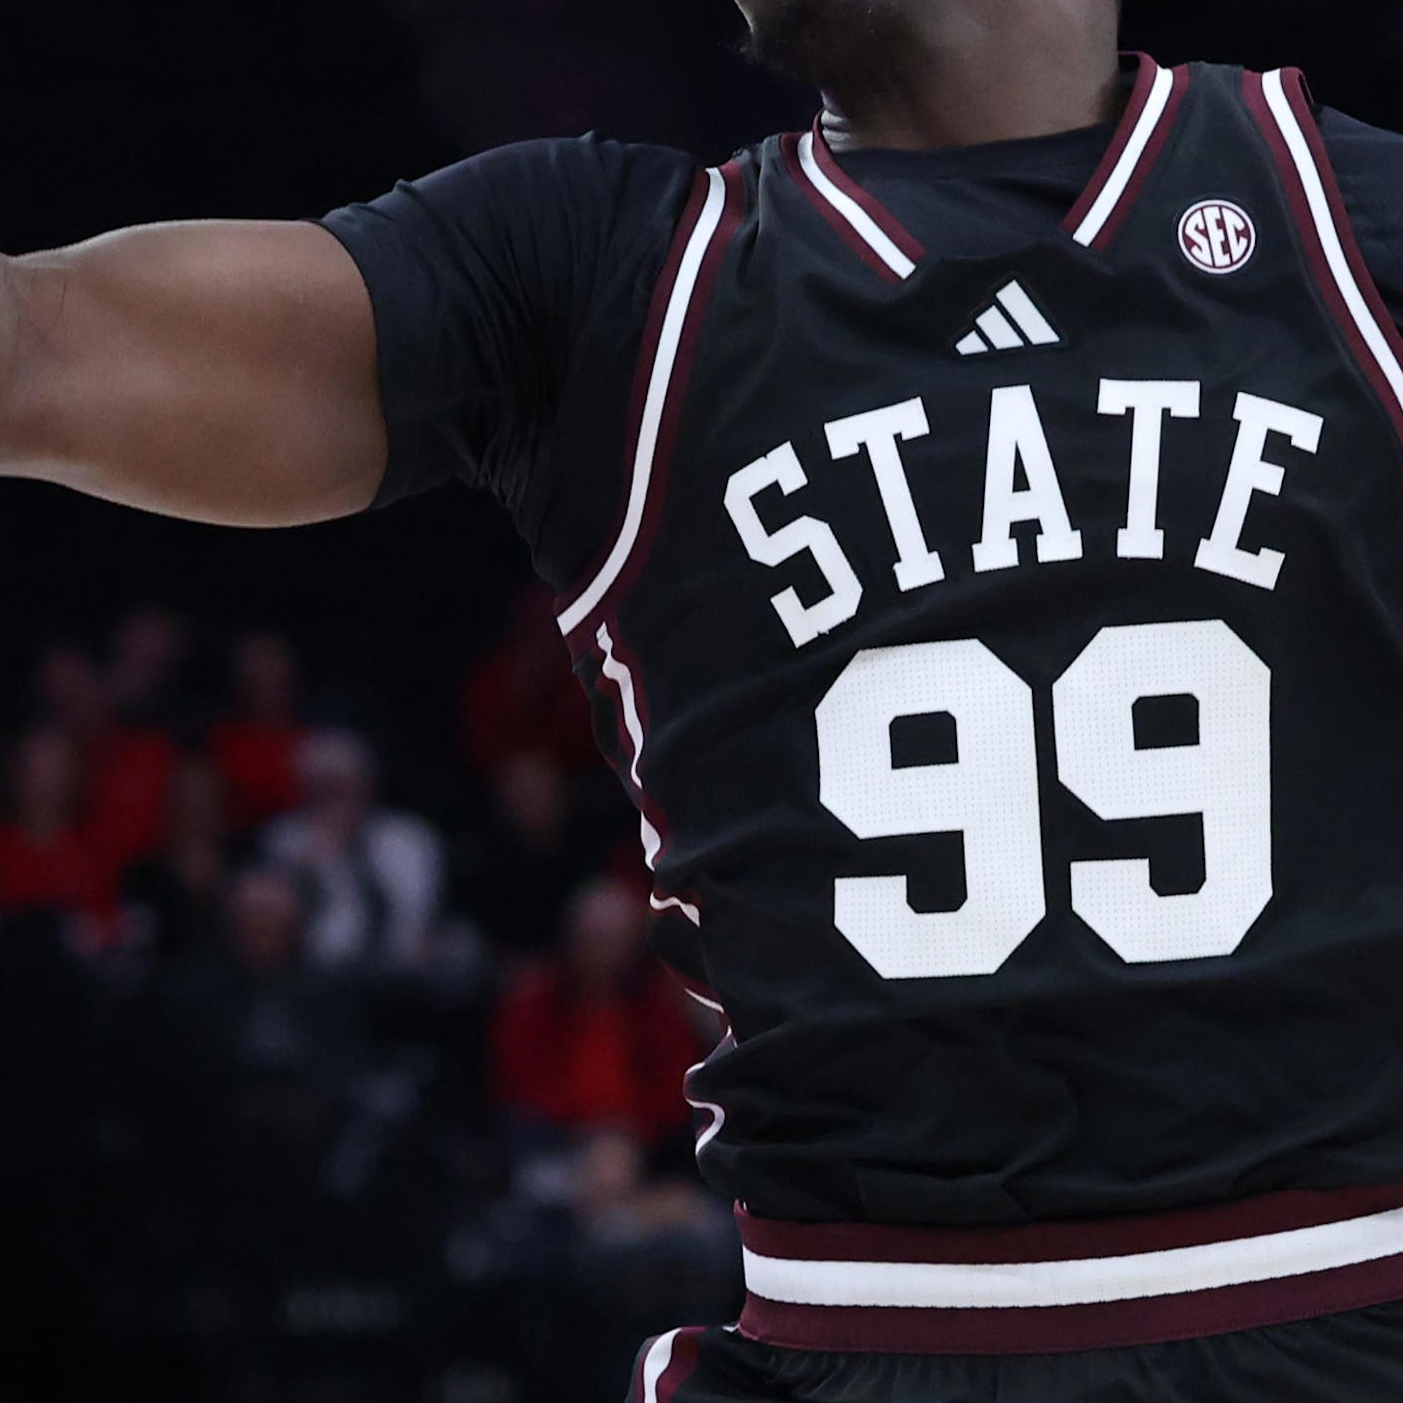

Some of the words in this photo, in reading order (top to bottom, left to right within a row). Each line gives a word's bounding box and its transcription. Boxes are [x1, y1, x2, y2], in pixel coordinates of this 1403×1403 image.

[1182, 202, 1251, 269] SEC
[723, 378, 1324, 648] STATE
[814, 618, 1273, 980] 99
